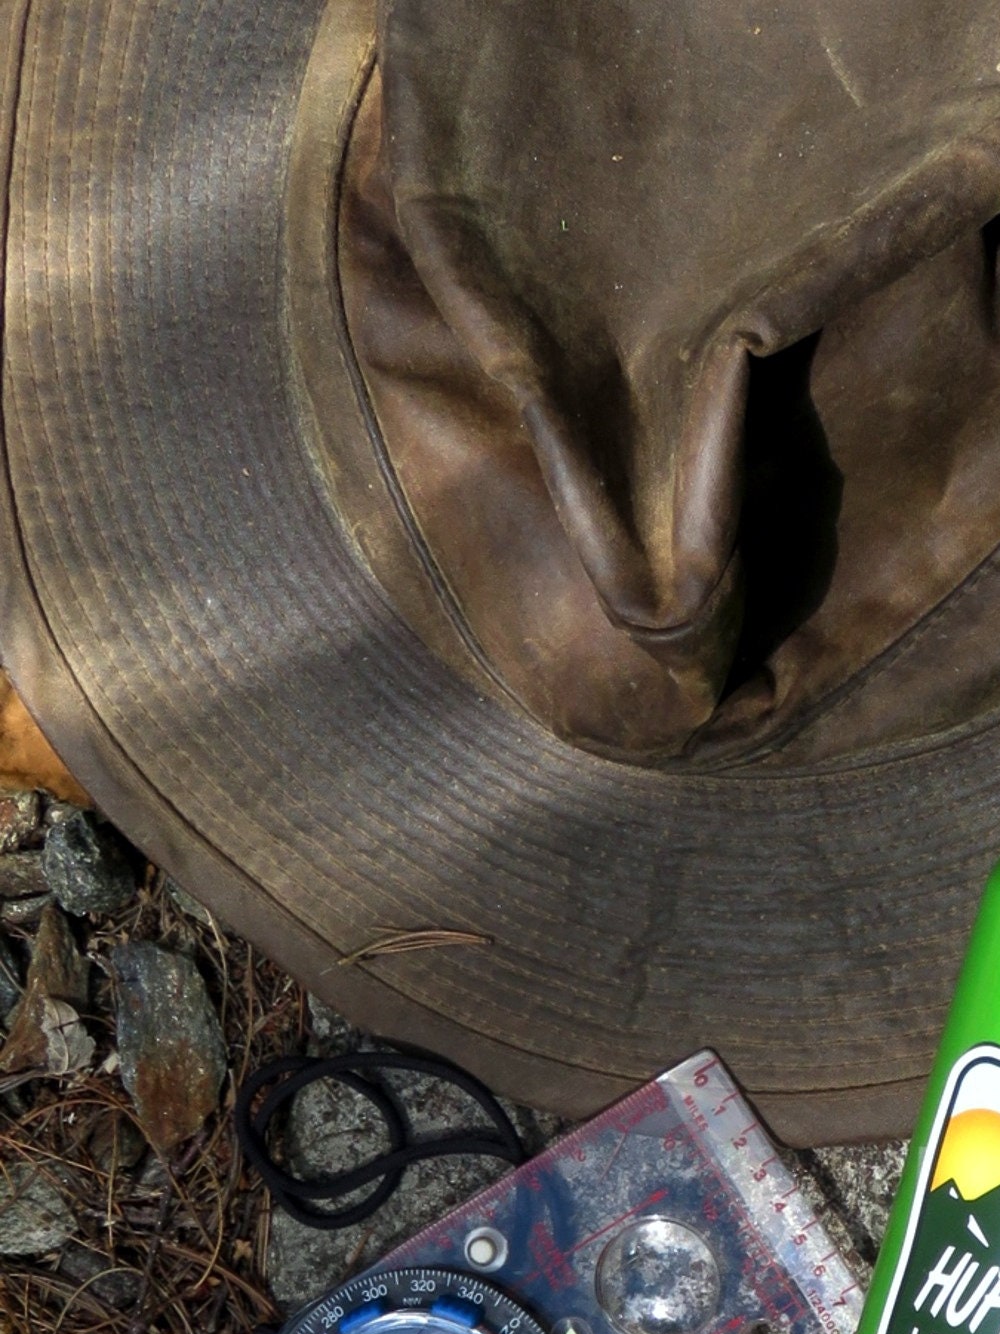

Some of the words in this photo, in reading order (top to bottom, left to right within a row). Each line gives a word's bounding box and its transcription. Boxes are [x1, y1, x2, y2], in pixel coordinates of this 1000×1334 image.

[361, 1284, 388, 1302] 300
[410, 1279, 436, 1292] 320
[457, 1286, 484, 1305] 340
[321, 1306, 345, 1329] 280
